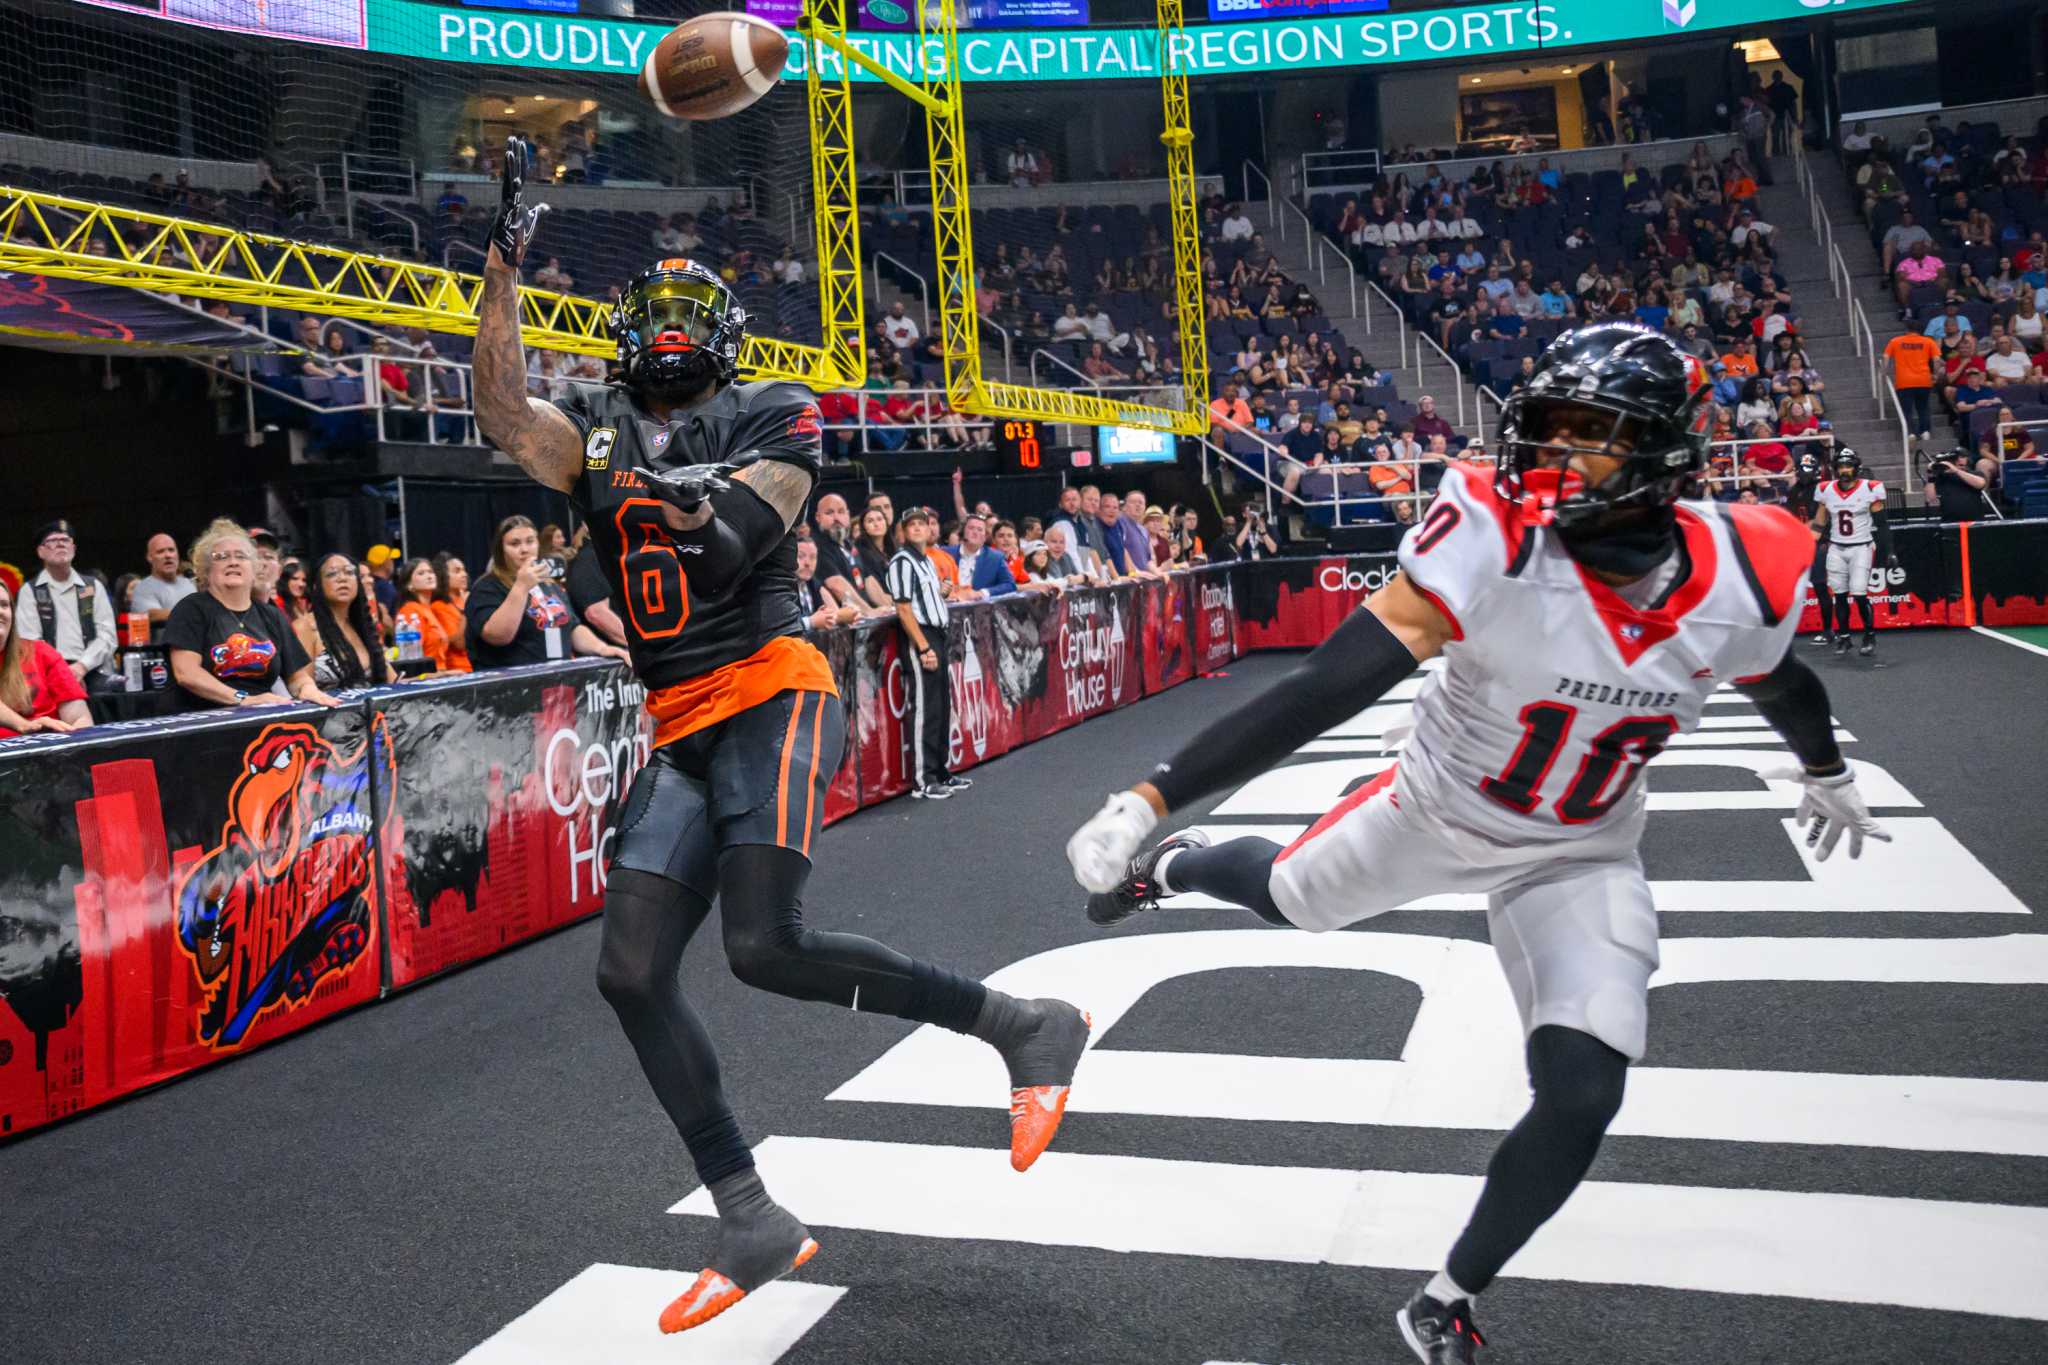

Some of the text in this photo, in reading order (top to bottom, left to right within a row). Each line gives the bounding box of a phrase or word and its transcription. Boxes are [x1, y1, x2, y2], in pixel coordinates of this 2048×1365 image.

[439, 14, 646, 68] PROUDLY
[784, 37, 948, 76] ORTING
[964, 36, 1153, 76] CAPITAL
[1167, 24, 1345, 71] REGION
[1360, 6, 1573, 58] SPORTS.
[586, 430, 614, 459] C
[1838, 509, 1854, 537] 6
[614, 497, 690, 641] 6
[1320, 564, 1401, 592] Clock
[1060, 622, 1110, 672] Century
[585, 681, 615, 714] The
[617, 677, 641, 706] Inn
[1066, 670, 1106, 717] House
[1555, 676, 1680, 708] PREDATORS
[544, 728, 649, 817] Cent
[1478, 699, 1681, 825] 10
[308, 812, 373, 838] ALBANY
